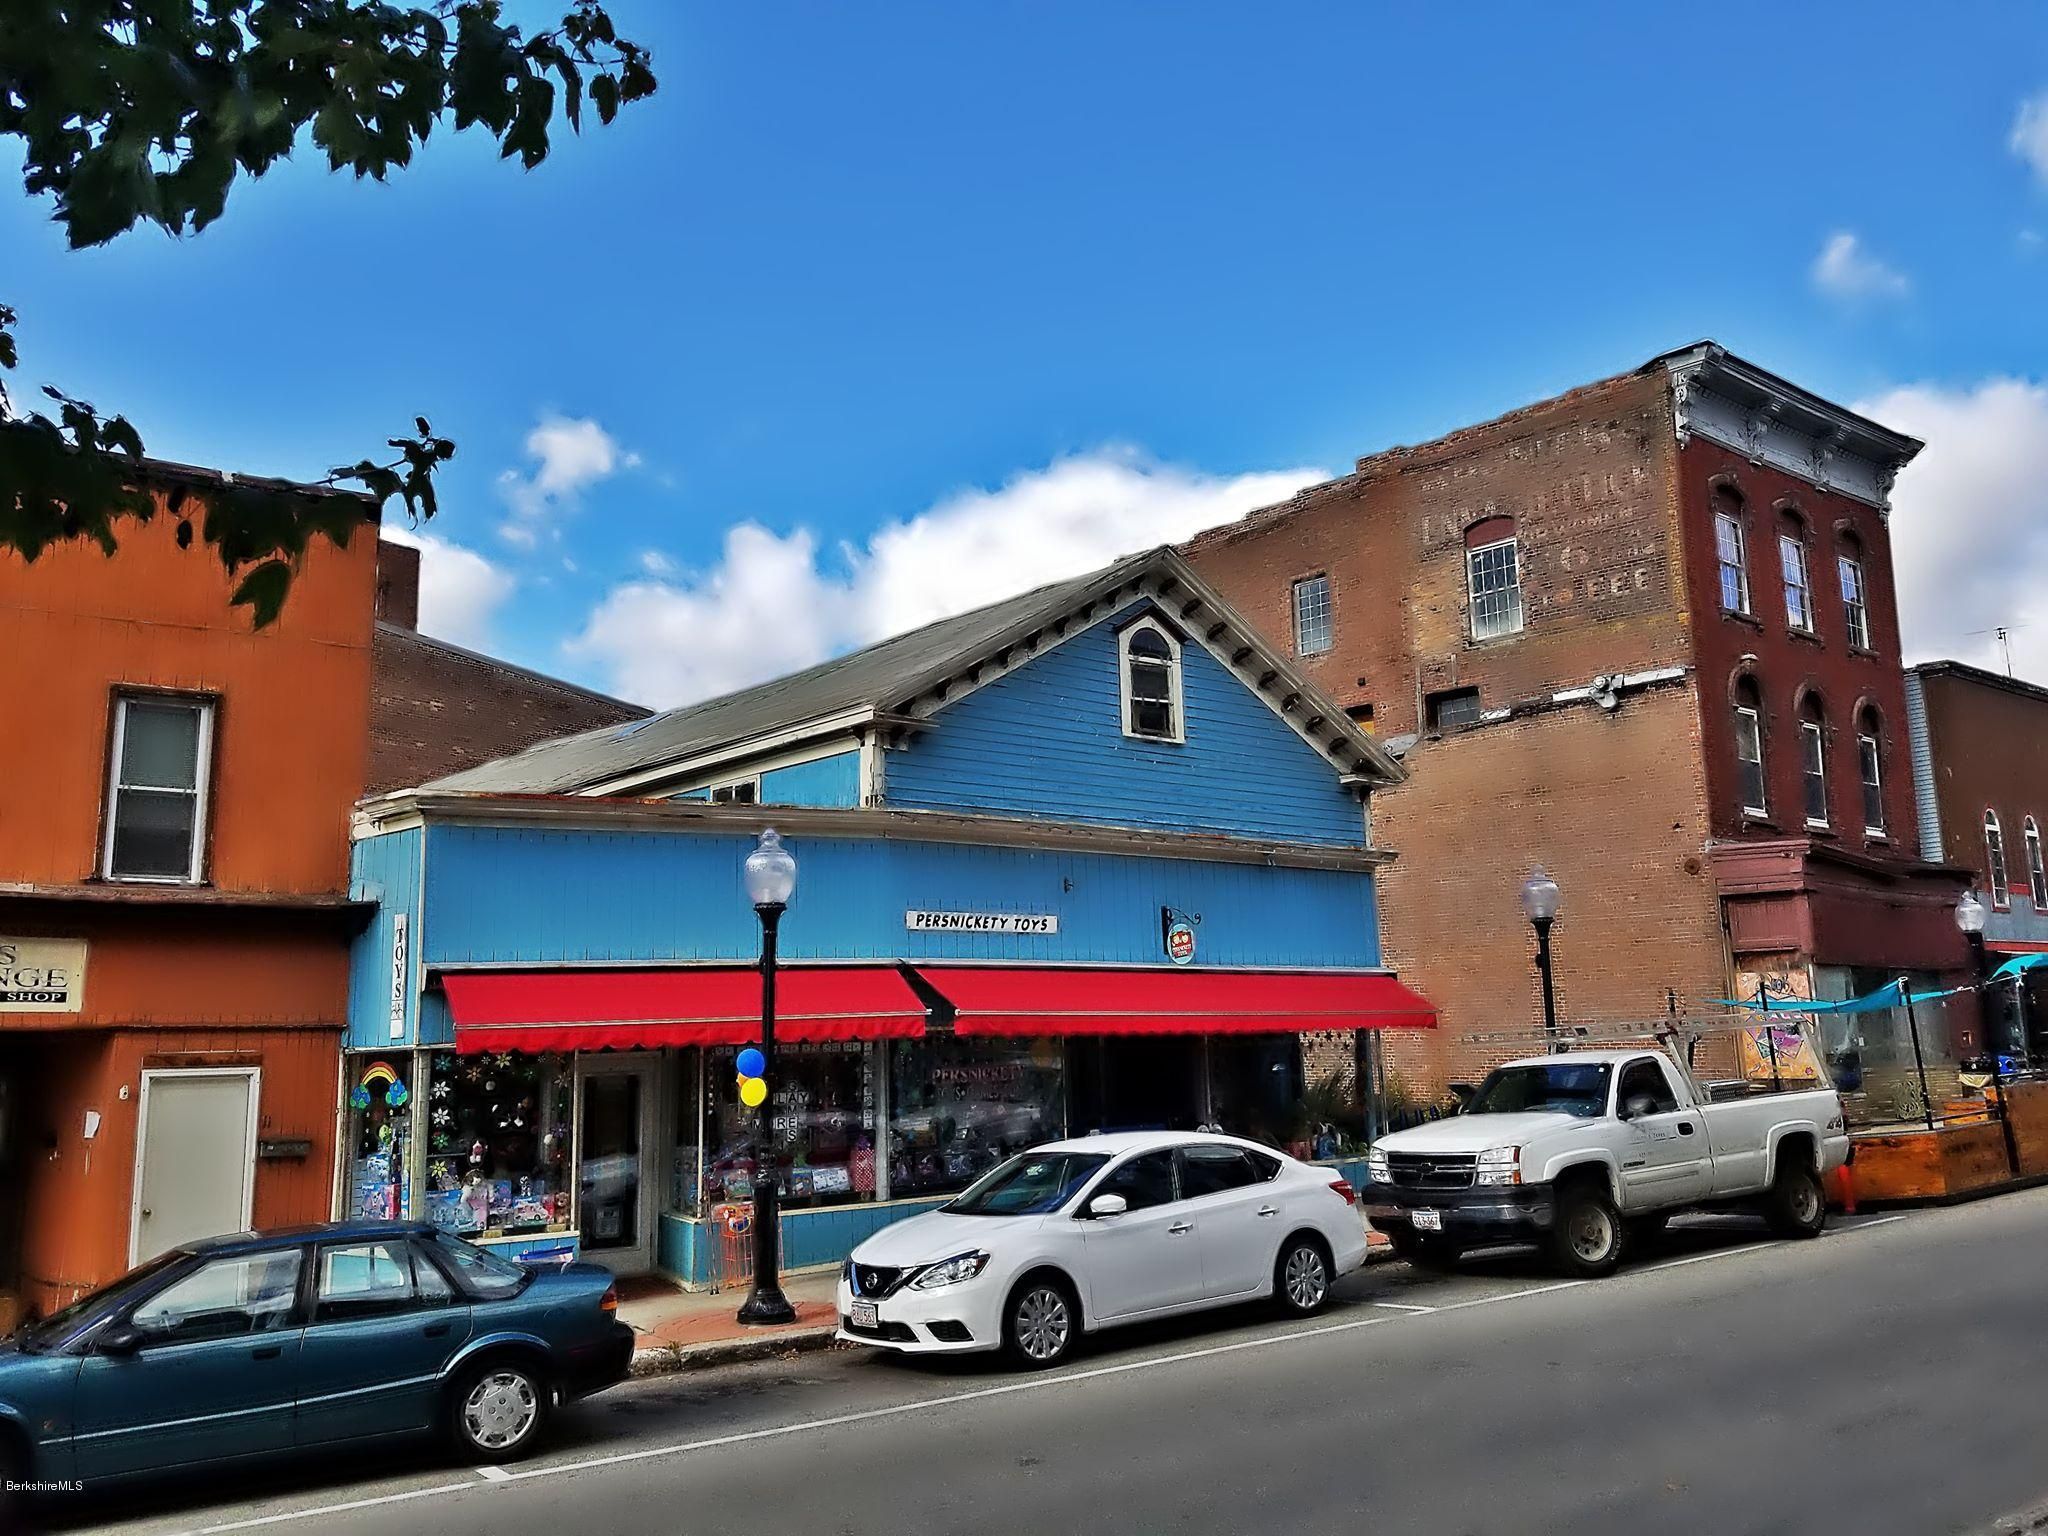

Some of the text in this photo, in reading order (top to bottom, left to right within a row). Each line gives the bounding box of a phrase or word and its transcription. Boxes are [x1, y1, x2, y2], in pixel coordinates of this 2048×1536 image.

[915, 913, 1048, 931] PERSNICKETY TOYS
[394, 928, 405, 999] TOYS
[6, 992, 62, 1002] SHOP
